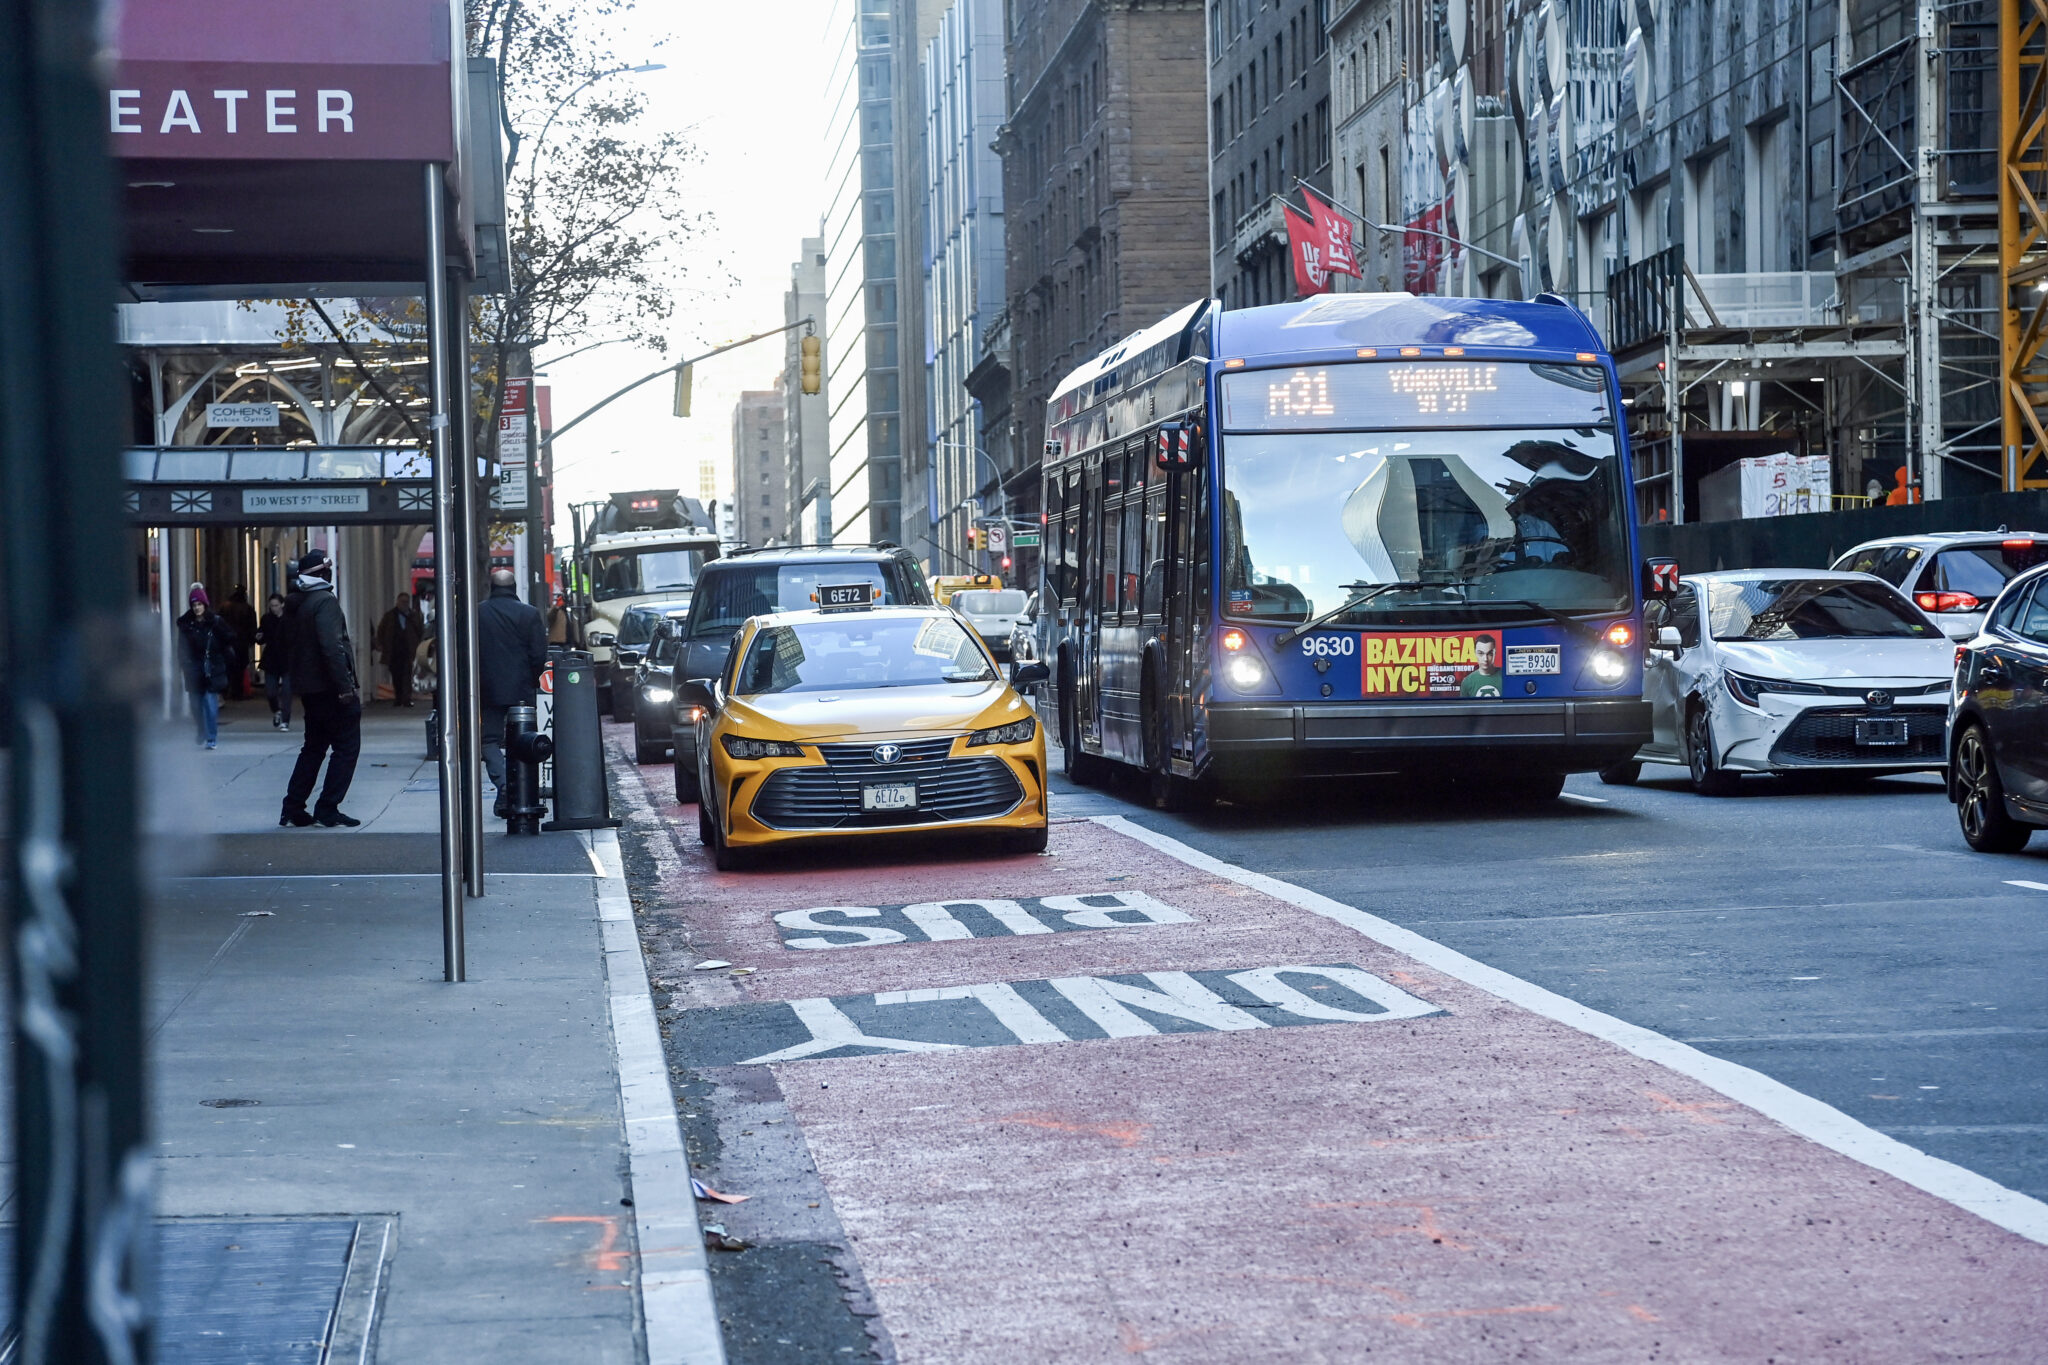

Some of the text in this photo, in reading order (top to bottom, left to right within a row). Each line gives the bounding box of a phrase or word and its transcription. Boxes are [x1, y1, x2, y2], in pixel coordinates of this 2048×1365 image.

[109, 89, 354, 133] EATER
[1388, 367, 1497, 392] YORKVILLE
[1269, 370, 1334, 416] M31
[212, 407, 271, 416] COHEN'S
[501, 417, 509, 429] 3
[502, 471, 509, 483] 5
[1772, 473, 1787, 488] 5
[250, 496, 267, 506] 130
[269, 496, 299, 505] WEST
[321, 494, 360, 504] STREET
[830, 588, 861, 602] 6E72
[1302, 636, 1354, 656] 9630
[1366, 637, 1479, 664] BAZINGA
[1534, 654, 1556, 668] 9360
[1366, 665, 1427, 693] NYC!
[772, 890, 1200, 950] BUS
[737, 964, 1444, 1065] ONLY
